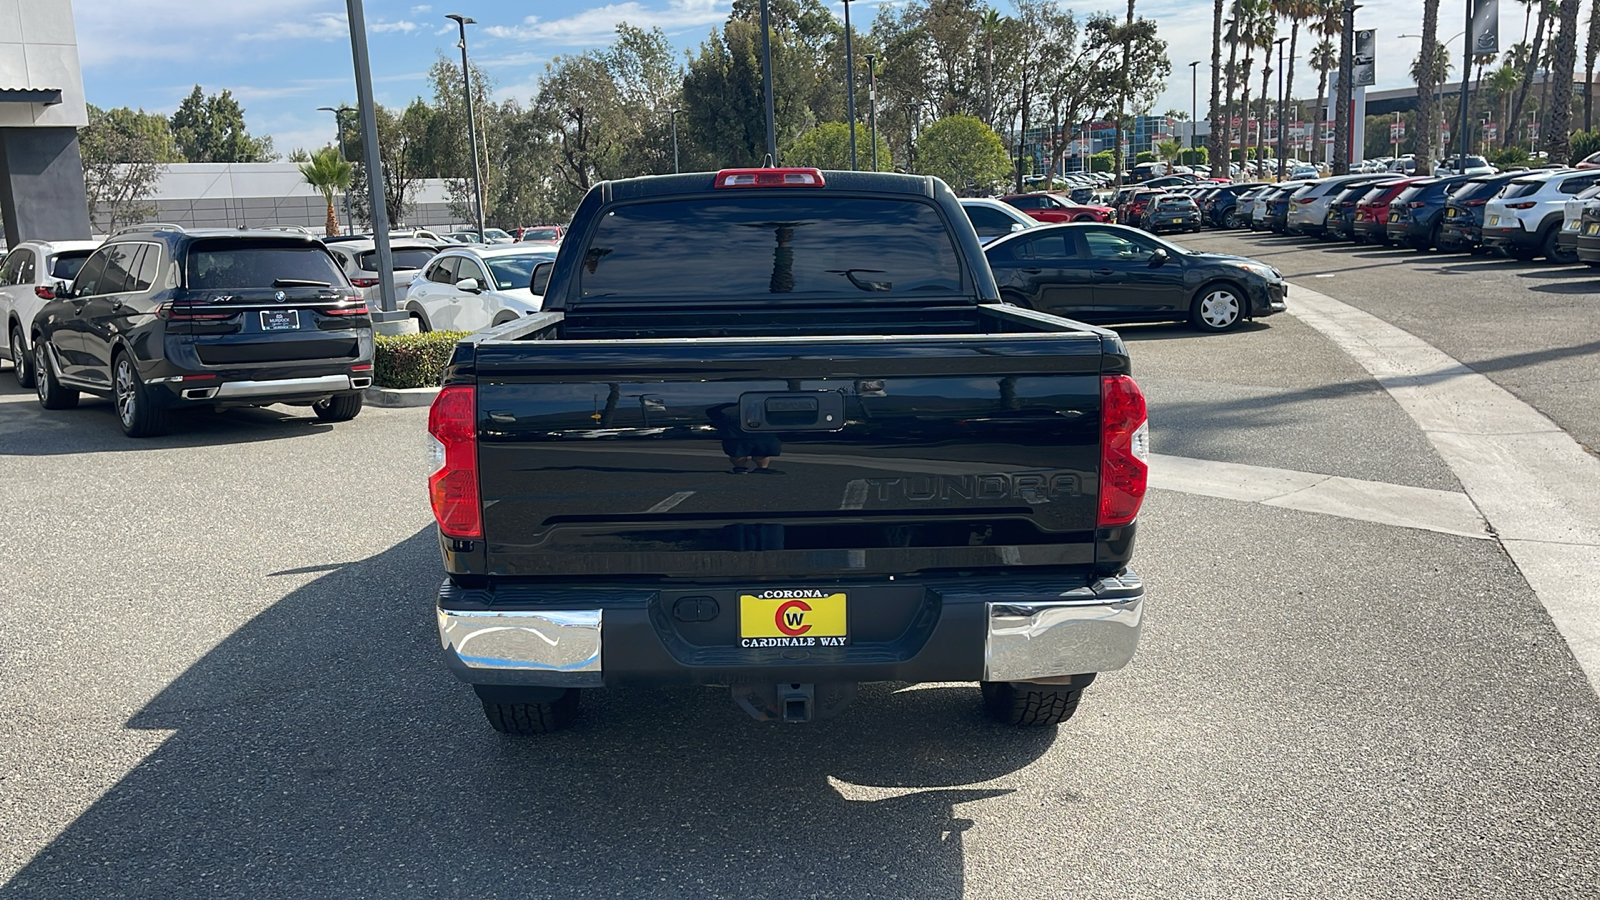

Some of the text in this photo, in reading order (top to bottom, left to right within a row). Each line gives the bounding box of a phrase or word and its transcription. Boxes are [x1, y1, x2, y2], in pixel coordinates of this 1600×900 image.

[865, 472, 1083, 501] TUNDRA
[763, 589, 823, 599] CORONA
[741, 637, 847, 648] CARDINALE WAY
